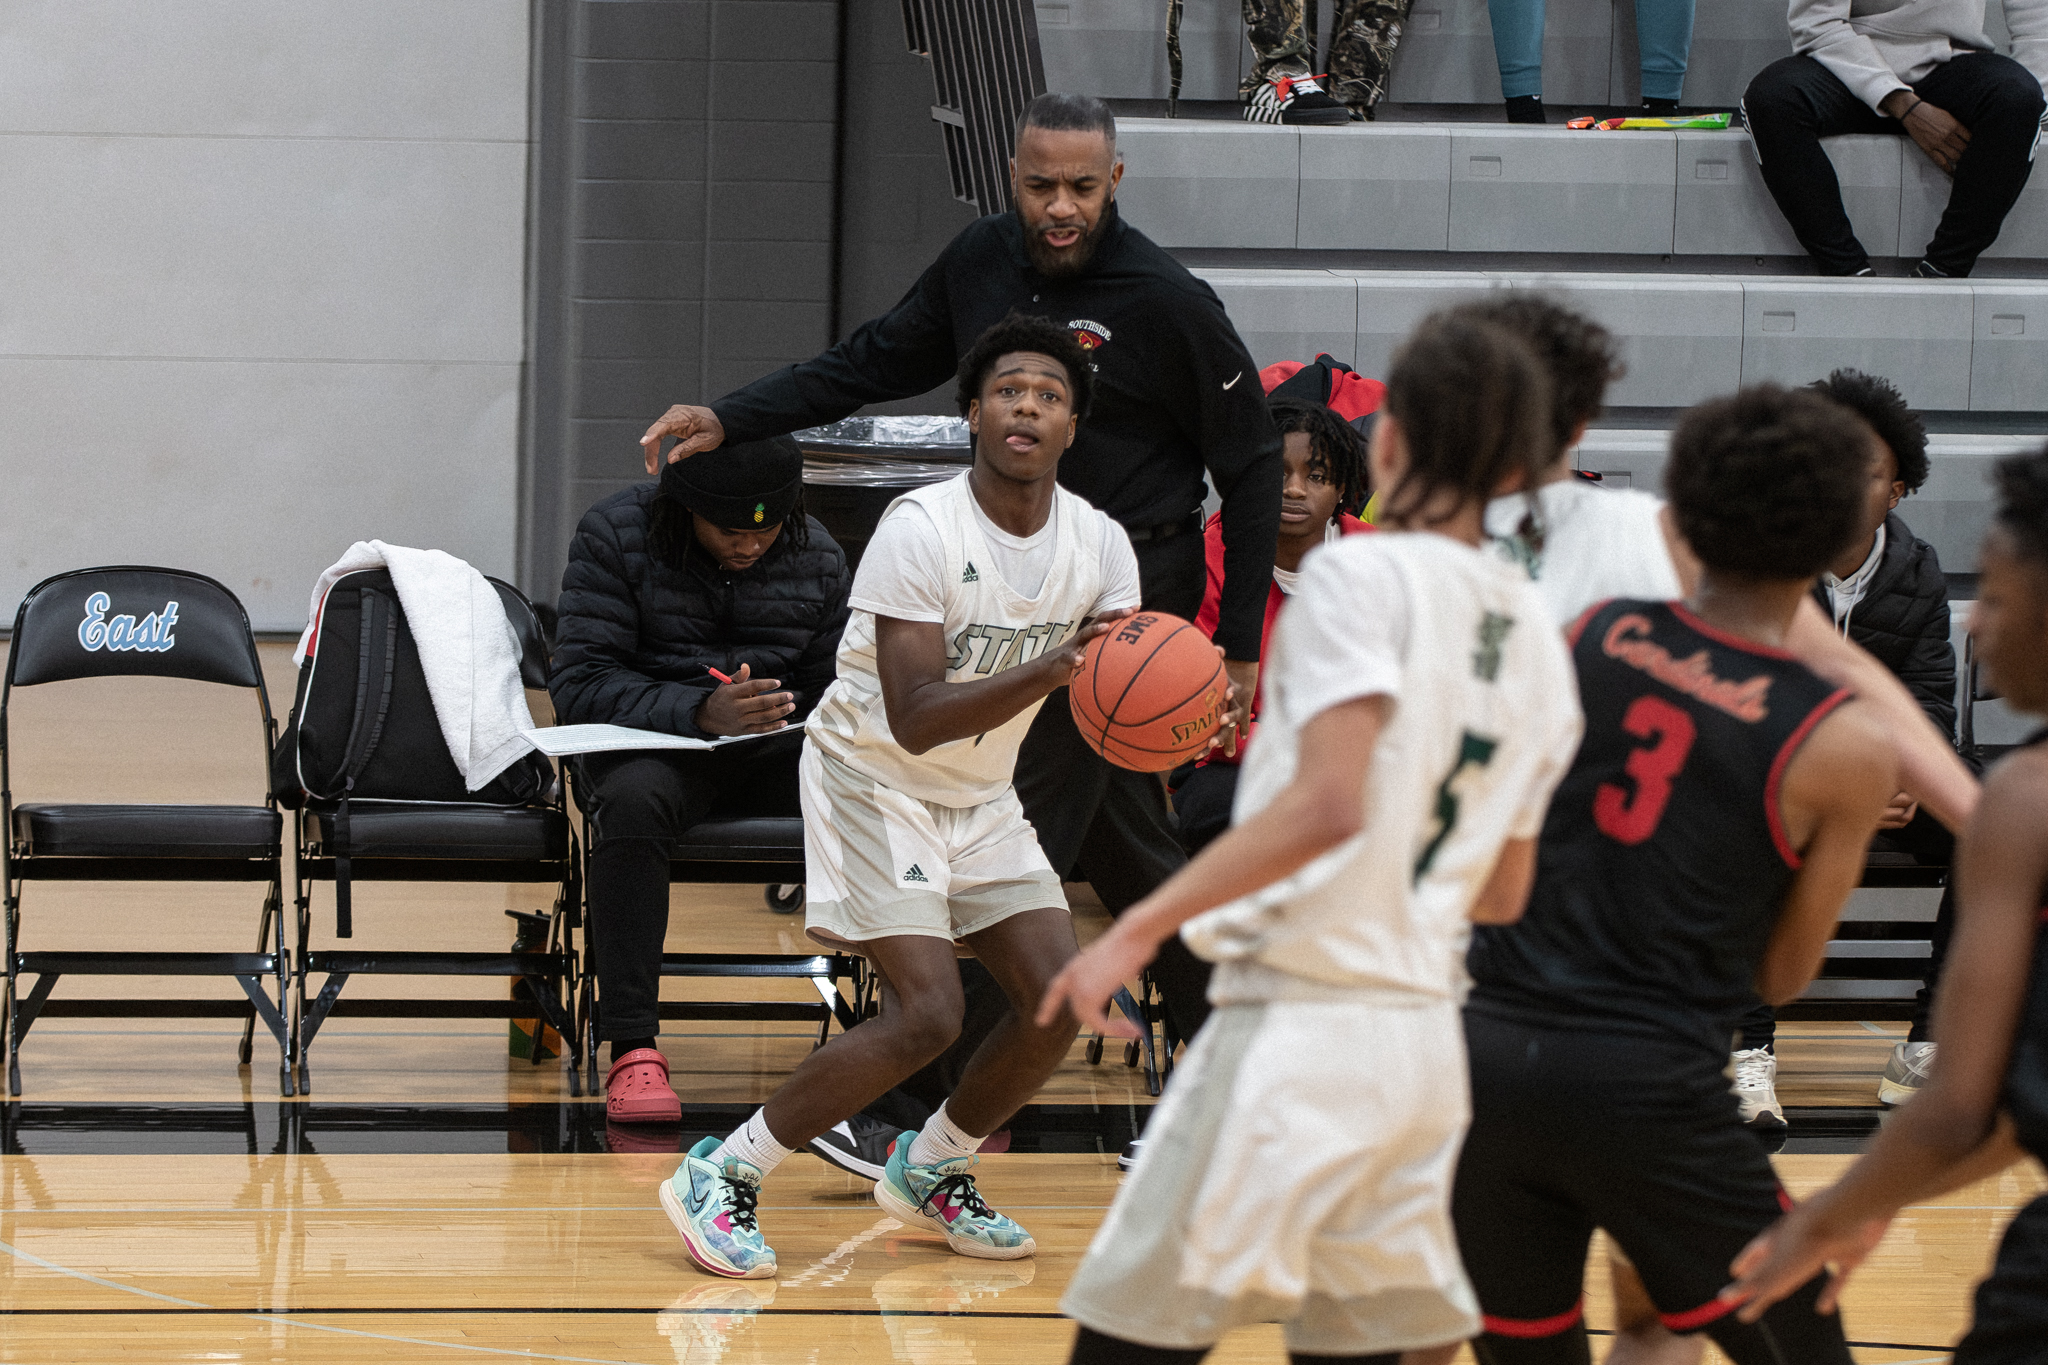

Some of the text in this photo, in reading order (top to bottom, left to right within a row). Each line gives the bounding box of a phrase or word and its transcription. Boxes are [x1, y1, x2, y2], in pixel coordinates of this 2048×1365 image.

[1067, 319, 1112, 342] SOUTHSIDE
[78, 591, 179, 652] East
[1592, 693, 1698, 846] 3
[903, 873, 929, 883] adidas
